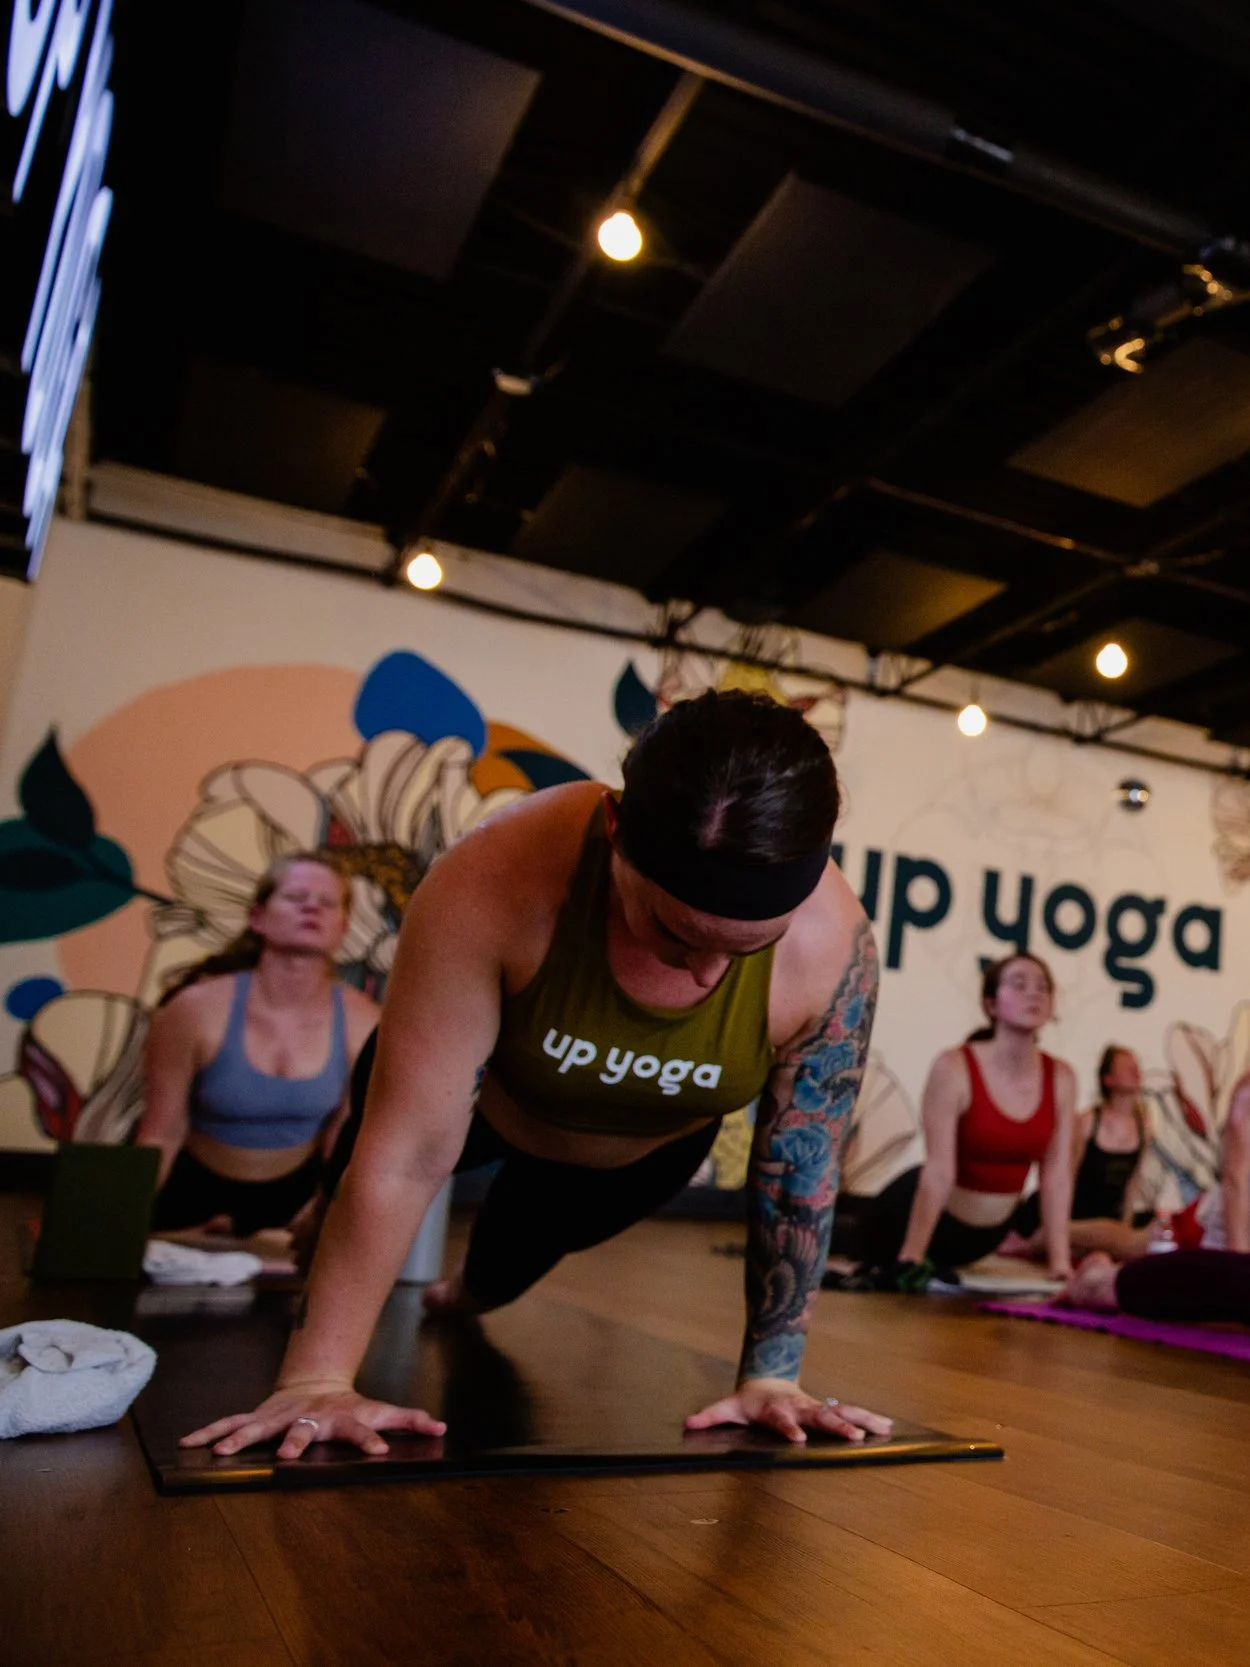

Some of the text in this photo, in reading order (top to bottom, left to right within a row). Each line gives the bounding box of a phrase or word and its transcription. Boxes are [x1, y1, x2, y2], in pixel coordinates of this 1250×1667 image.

[977, 868, 1223, 1009] yoga
[542, 1027, 723, 1096] up yoga
